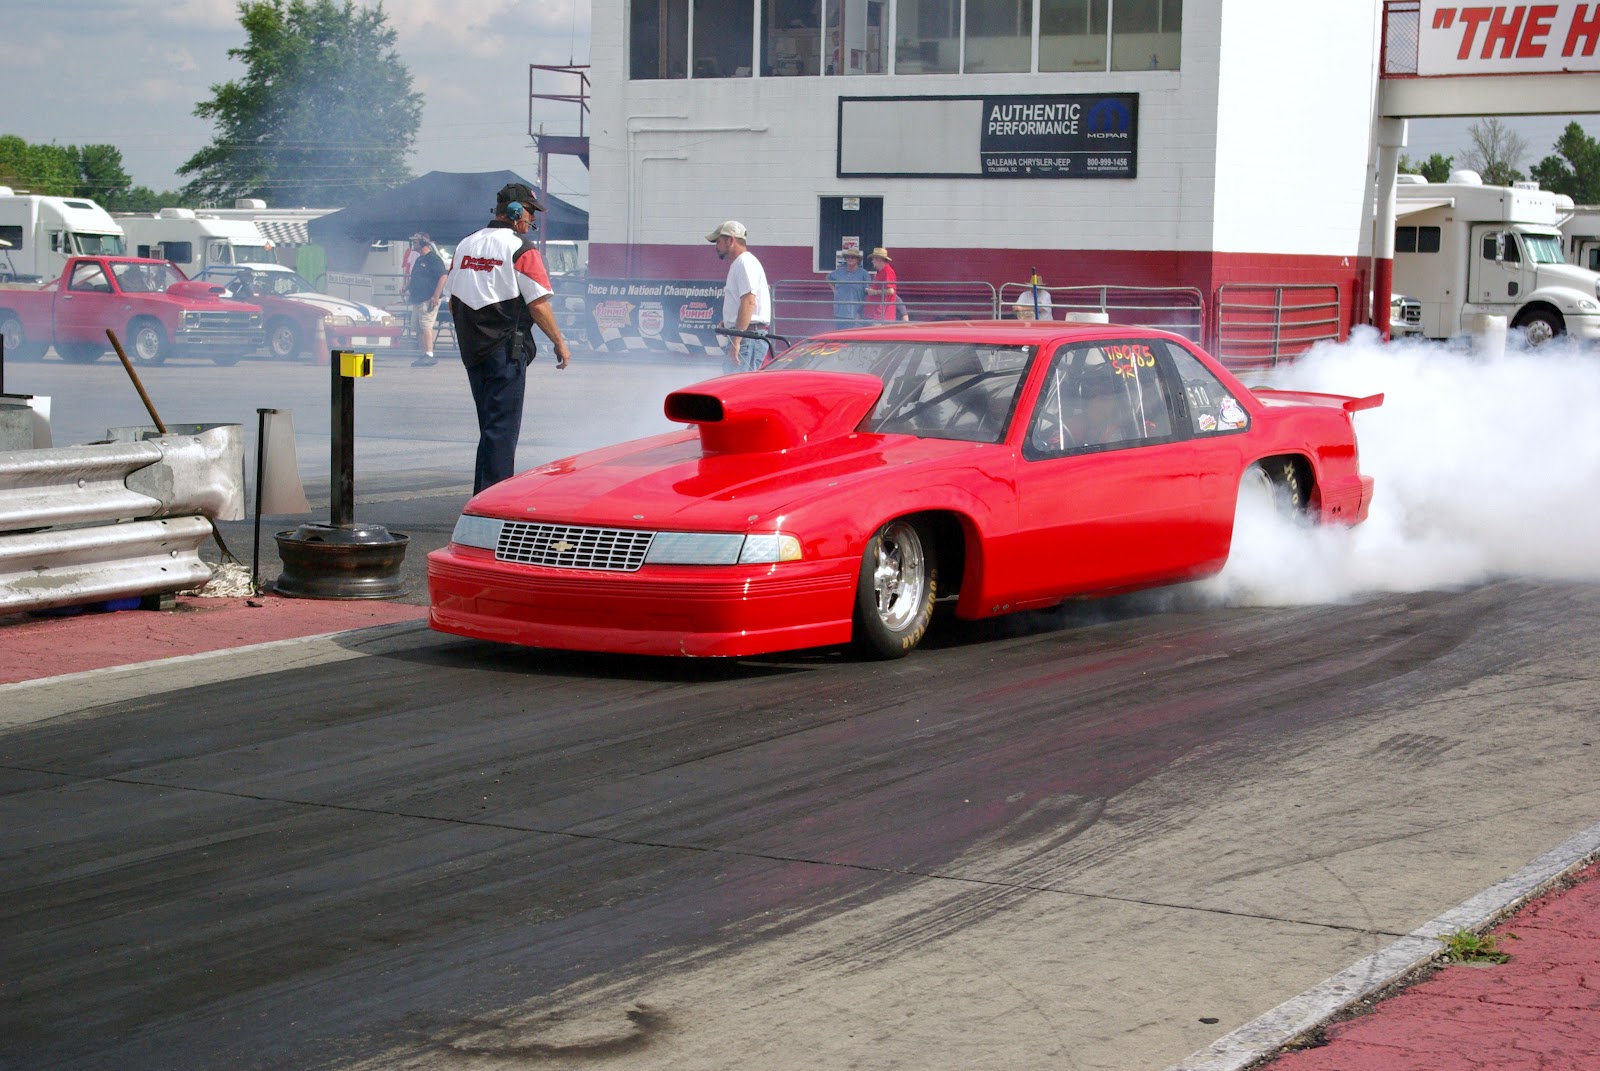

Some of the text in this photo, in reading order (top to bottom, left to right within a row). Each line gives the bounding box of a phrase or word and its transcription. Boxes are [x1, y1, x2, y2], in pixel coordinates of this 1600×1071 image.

[1432, 5, 1558, 60] "THE
[990, 103, 1081, 121] AUTHENTIC
[988, 121, 1079, 135] PERFORMANCE
[986, 158, 1071, 166] GALEANA CHRYSLER-JEEP
[1087, 157, 1128, 166] 800-999-1456
[587, 284, 607, 295] Race
[610, 285, 619, 295] to
[628, 285, 662, 296] National
[680, 305, 713, 321] SUMMIT
